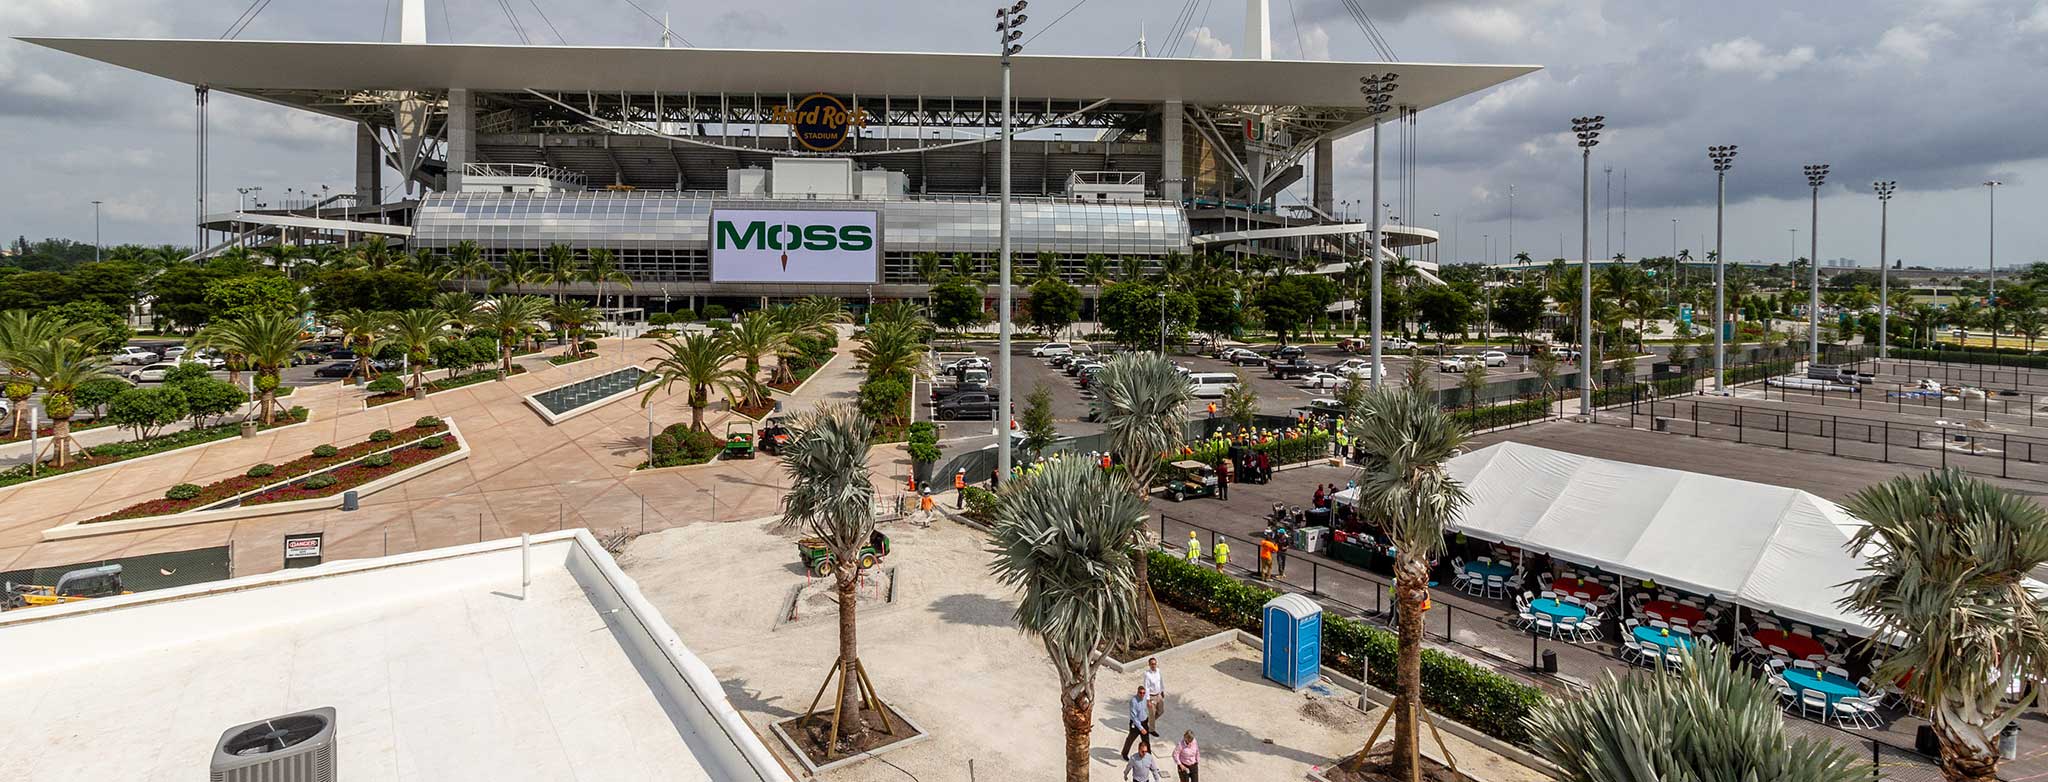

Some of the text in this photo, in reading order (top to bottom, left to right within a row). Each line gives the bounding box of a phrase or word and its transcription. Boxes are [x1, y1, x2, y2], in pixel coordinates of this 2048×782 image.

[772, 105, 867, 129] Hard Rock
[803, 132, 838, 140] STADIUM
[290, 540, 317, 548] DANGER
